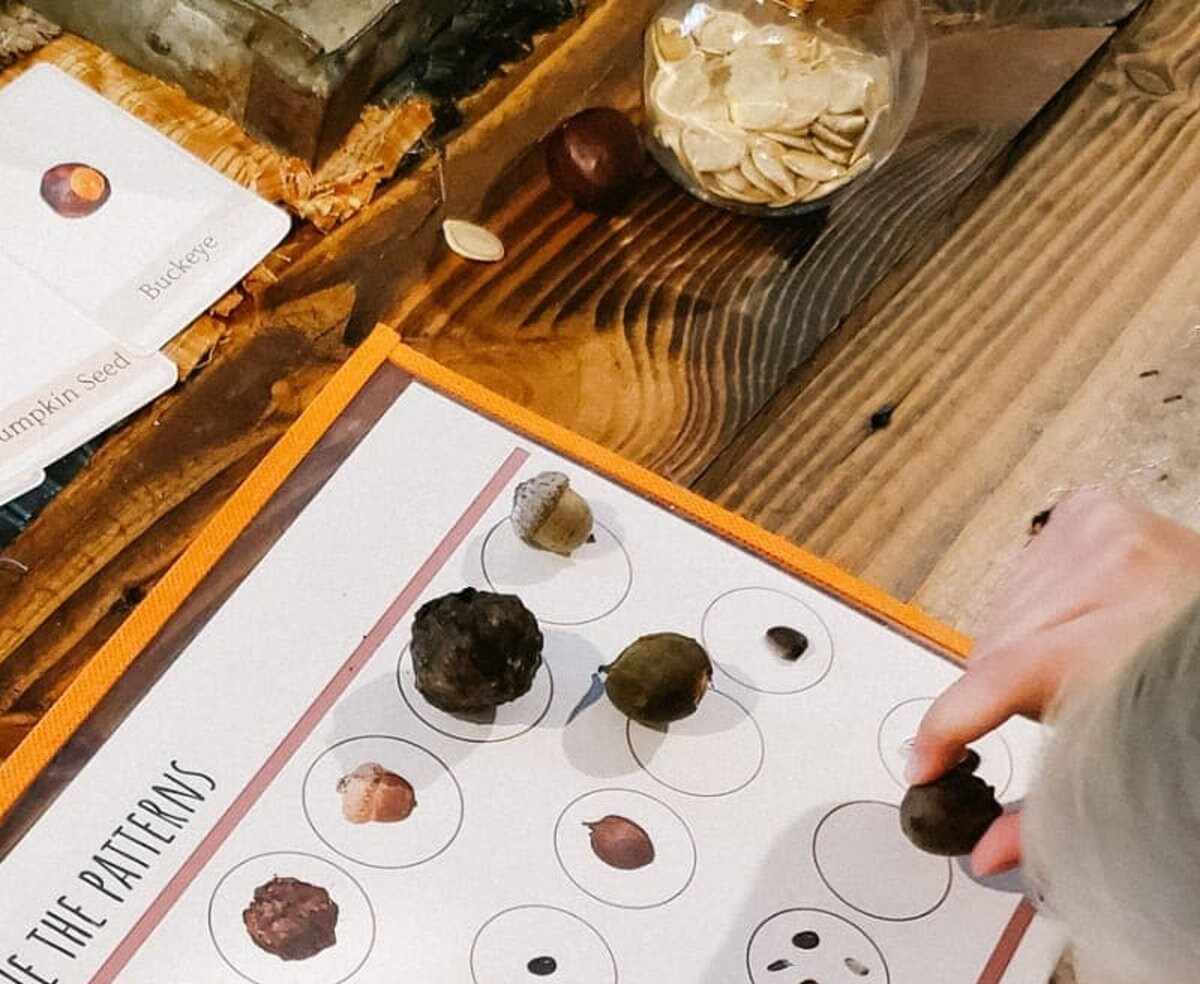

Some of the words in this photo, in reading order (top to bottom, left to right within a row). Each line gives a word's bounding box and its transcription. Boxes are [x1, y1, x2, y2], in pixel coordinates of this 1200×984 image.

[138, 236, 218, 300] Buckeye
[76, 351, 132, 391] Seed
[26, 895, 107, 959] THE
[78, 759, 217, 903] PATTERNS
